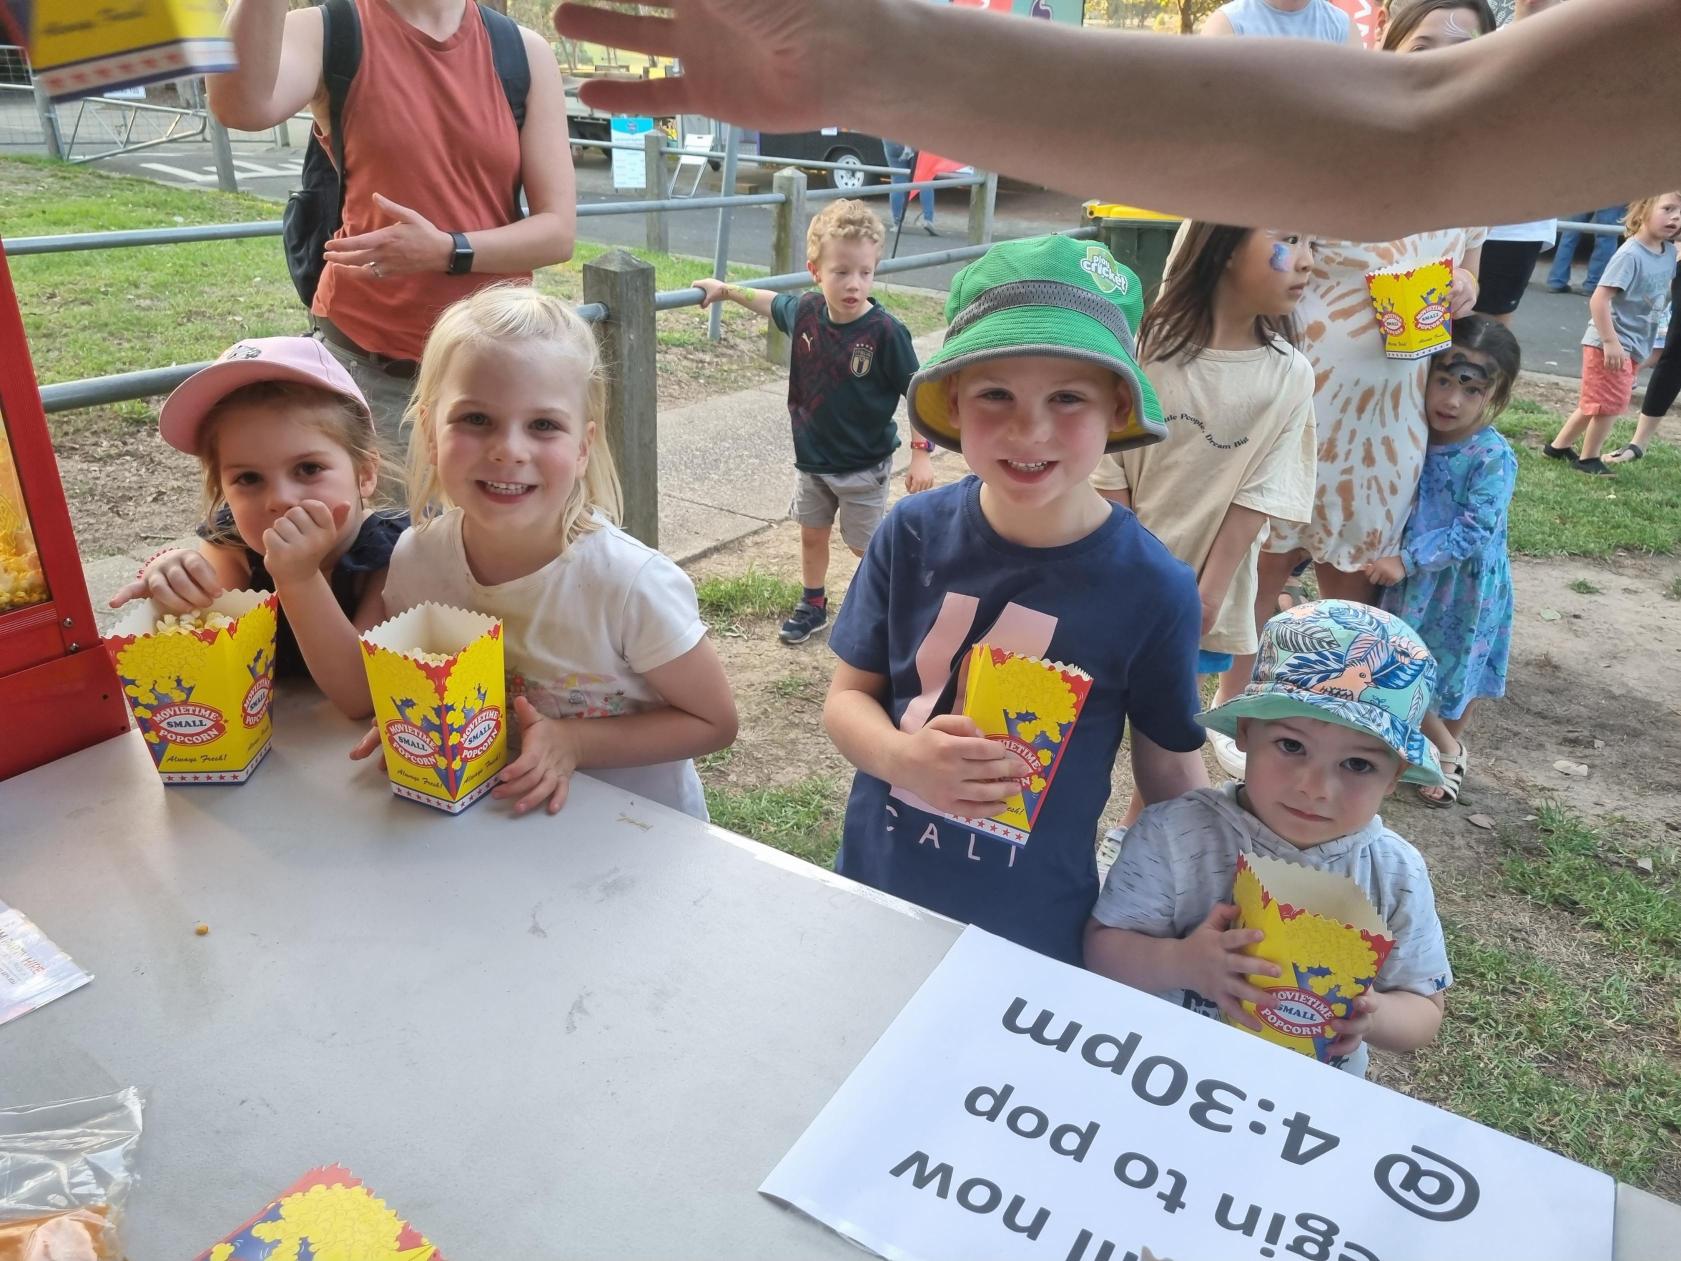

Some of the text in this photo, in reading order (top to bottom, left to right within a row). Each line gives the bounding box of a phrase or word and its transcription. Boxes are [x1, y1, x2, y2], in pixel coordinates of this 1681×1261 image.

[152, 706, 219, 723] MOVIETIME
[166, 719, 207, 728] SMALL
[460, 710, 499, 745] MOVIETIME
[159, 728, 219, 744] POPCORN
[389, 722, 436, 750] MOVIETIME
[398, 735, 428, 752] SMALL
[462, 729, 498, 759] POPCORN
[467, 723, 492, 746] SMALL
[168, 754, 228, 763] Always Fresh!
[392, 741, 436, 766] POPCORN
[1001, 738, 1042, 770] IETIME
[1006, 806, 1025, 816] esh!
[1260, 1008, 1322, 1035] POPCORN
[1278, 1004, 1317, 1021] SMALL
[1001, 996, 1481, 1222] @ 4:30pm
[964, 1083, 1101, 1163] pop
[889, 1150, 1051, 1241] now
[1114, 1151, 1188, 1214] to
